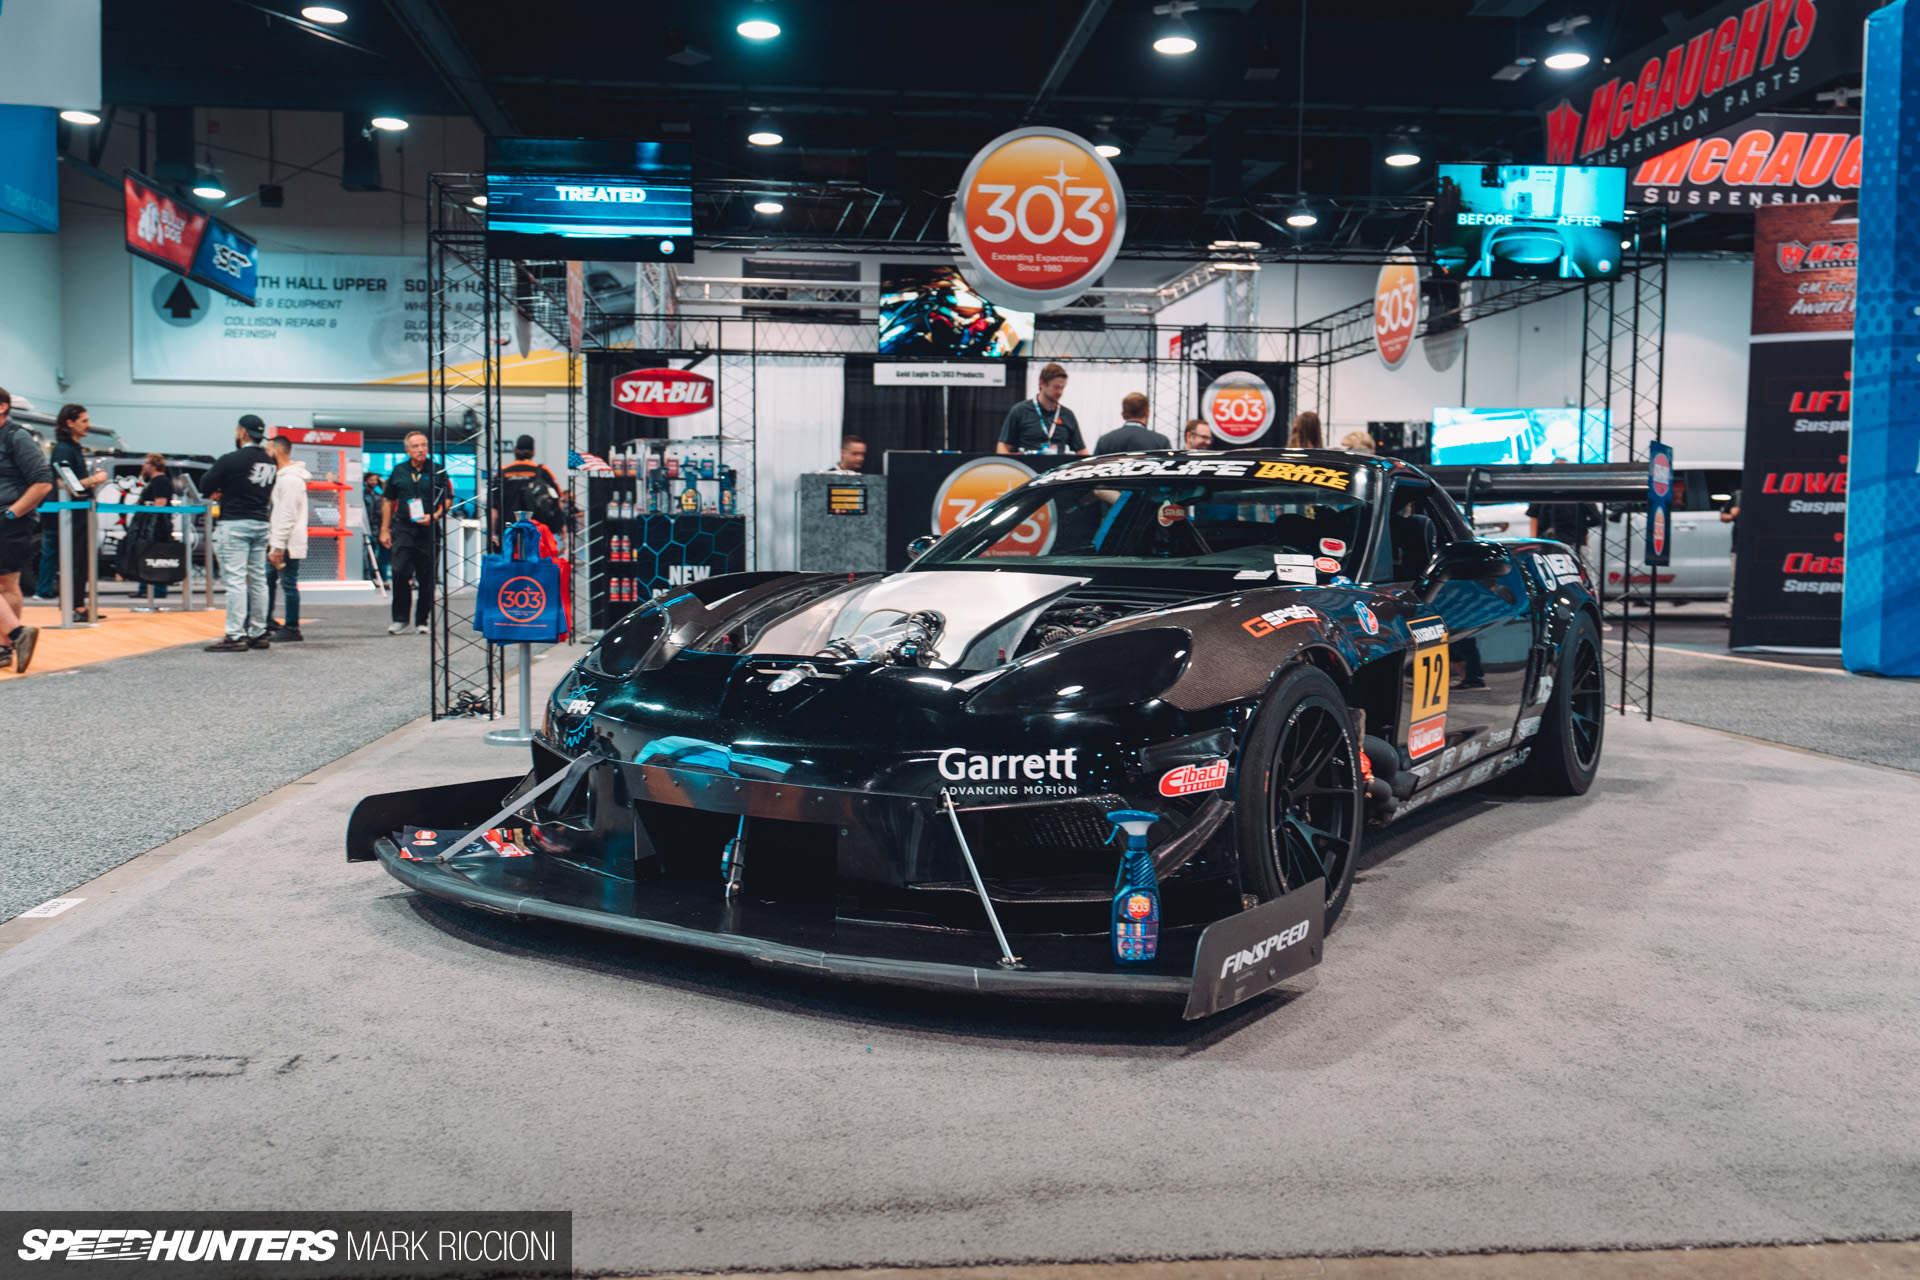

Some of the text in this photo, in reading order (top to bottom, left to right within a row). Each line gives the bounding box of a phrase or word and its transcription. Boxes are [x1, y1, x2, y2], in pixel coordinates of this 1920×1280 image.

[1725, 67, 1799, 112] PARTS
[555, 186, 646, 202] TREATED
[1457, 213, 1602, 227] BEFORE AFTER
[991, 252, 1089, 263] Exceeding Expectations
[1017, 263, 1063, 272] Since 1980
[286, 276, 327, 290] HALL
[333, 277, 387, 292] UPPER
[277, 299, 342, 310] EQUIPMENT
[1378, 283, 1414, 335] 303
[1789, 296, 1849, 315] Award
[285, 318, 326, 328] REPAIR
[329, 319, 338, 329] &
[223, 329, 277, 340] REFINISH
[956, 371, 984, 379] Products
[618, 380, 708, 404] STA-BIL
[1215, 398, 1263, 422] 303
[600, 469, 615, 478] USA
[1259, 461, 1349, 478] TRACK
[1254, 470, 1350, 490] BATTLE
[669, 565, 711, 586] NEW
[503, 591, 541, 608] 303
[567, 700, 596, 715] PPG
[938, 747, 1077, 780] Garrett
[1161, 761, 1227, 795] Eibach
[940, 786, 1078, 795] ADVANCING MOTION
[1131, 903, 1149, 913] 303
[1220, 920, 1310, 980] FINSPEED
